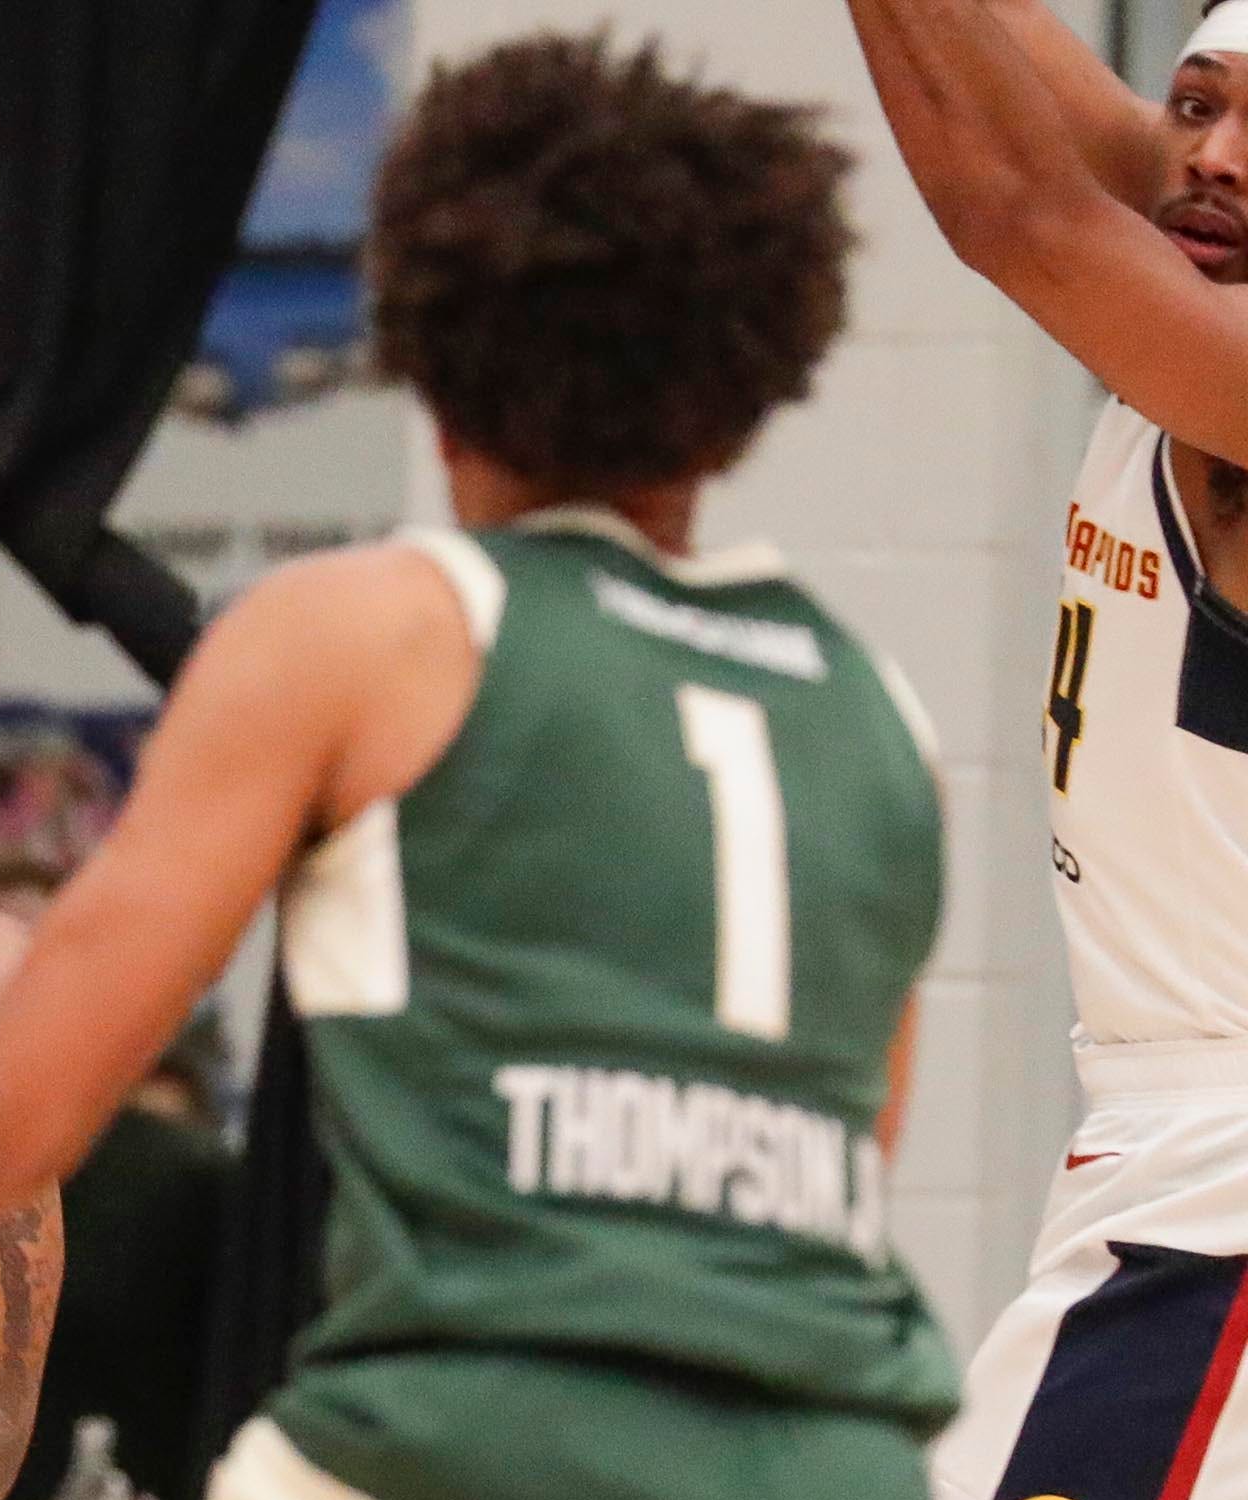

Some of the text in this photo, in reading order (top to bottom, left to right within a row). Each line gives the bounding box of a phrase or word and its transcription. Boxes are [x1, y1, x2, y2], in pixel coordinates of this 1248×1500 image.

[1042, 597, 1096, 798] 4
[674, 680, 790, 1043] 1
[492, 1065, 848, 1245] THOMPSON
